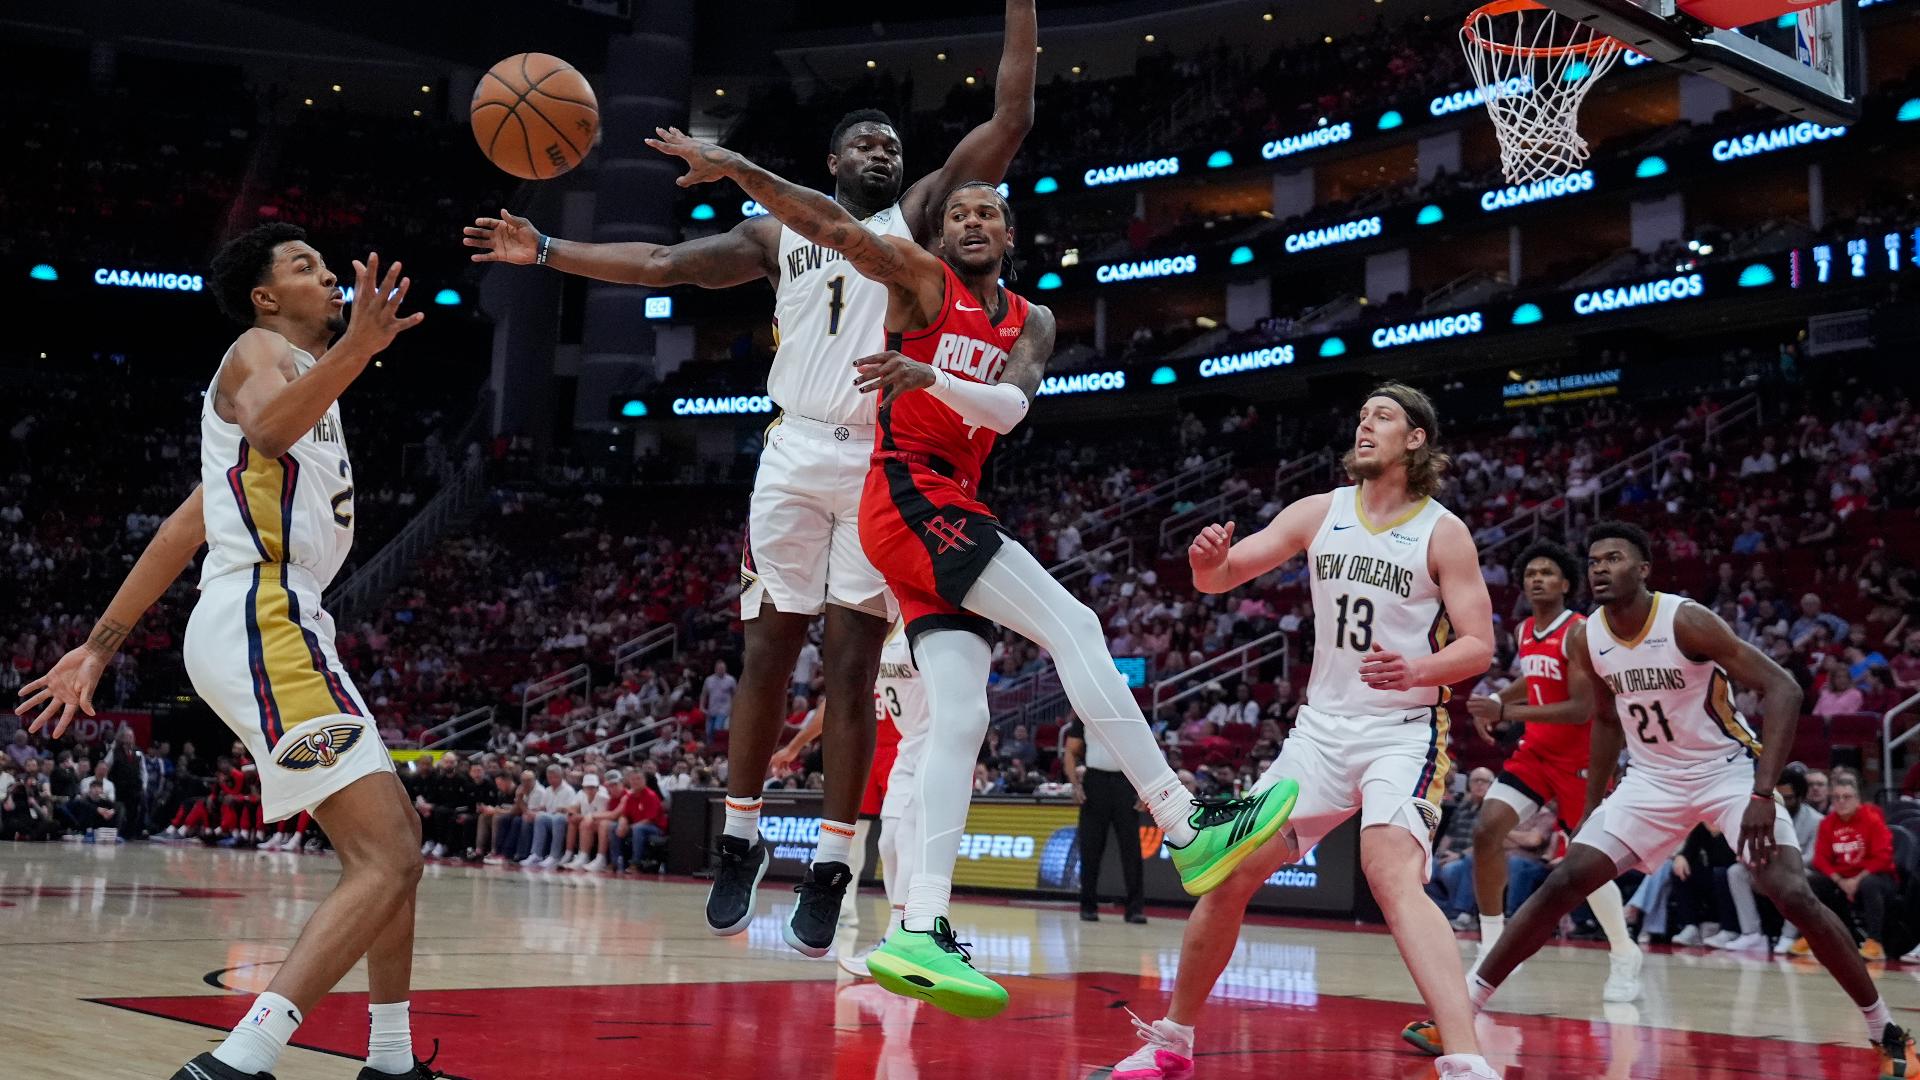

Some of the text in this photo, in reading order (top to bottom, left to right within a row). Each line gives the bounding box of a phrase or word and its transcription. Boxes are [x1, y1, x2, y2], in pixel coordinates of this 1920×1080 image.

[1262, 122, 1351, 160] CASAMIGOS
[1084, 156, 1180, 187] CASAMIGOS
[1481, 169, 1594, 212] CASAMIGOS
[1285, 216, 1381, 253] CASAMIGOS
[787, 244, 823, 282] NEW
[1096, 254, 1197, 284] CASAMIGOS
[1817, 260, 1829, 282] 7
[1851, 254, 1865, 277] 2
[1888, 248, 1899, 271] 1
[95, 268, 203, 291] CASAMIGOS
[1574, 274, 1702, 314] CASAMIGOS
[827, 275, 845, 336] 1
[1371, 312, 1482, 348] CASAMIGOS
[931, 332, 1009, 386] ROCKE
[1199, 344, 1295, 378] CASAMIGOS
[1036, 371, 1126, 396] ASAMIGOS
[672, 395, 773, 415] CASAMIGOS
[1316, 553, 1414, 599] NEW ORLEANS
[1335, 593, 1374, 653] 13
[1604, 667, 1686, 695] EW ORLEANS
[885, 686, 902, 718] 3
[1628, 700, 1675, 744] 21
[773, 844, 810, 864] driving
